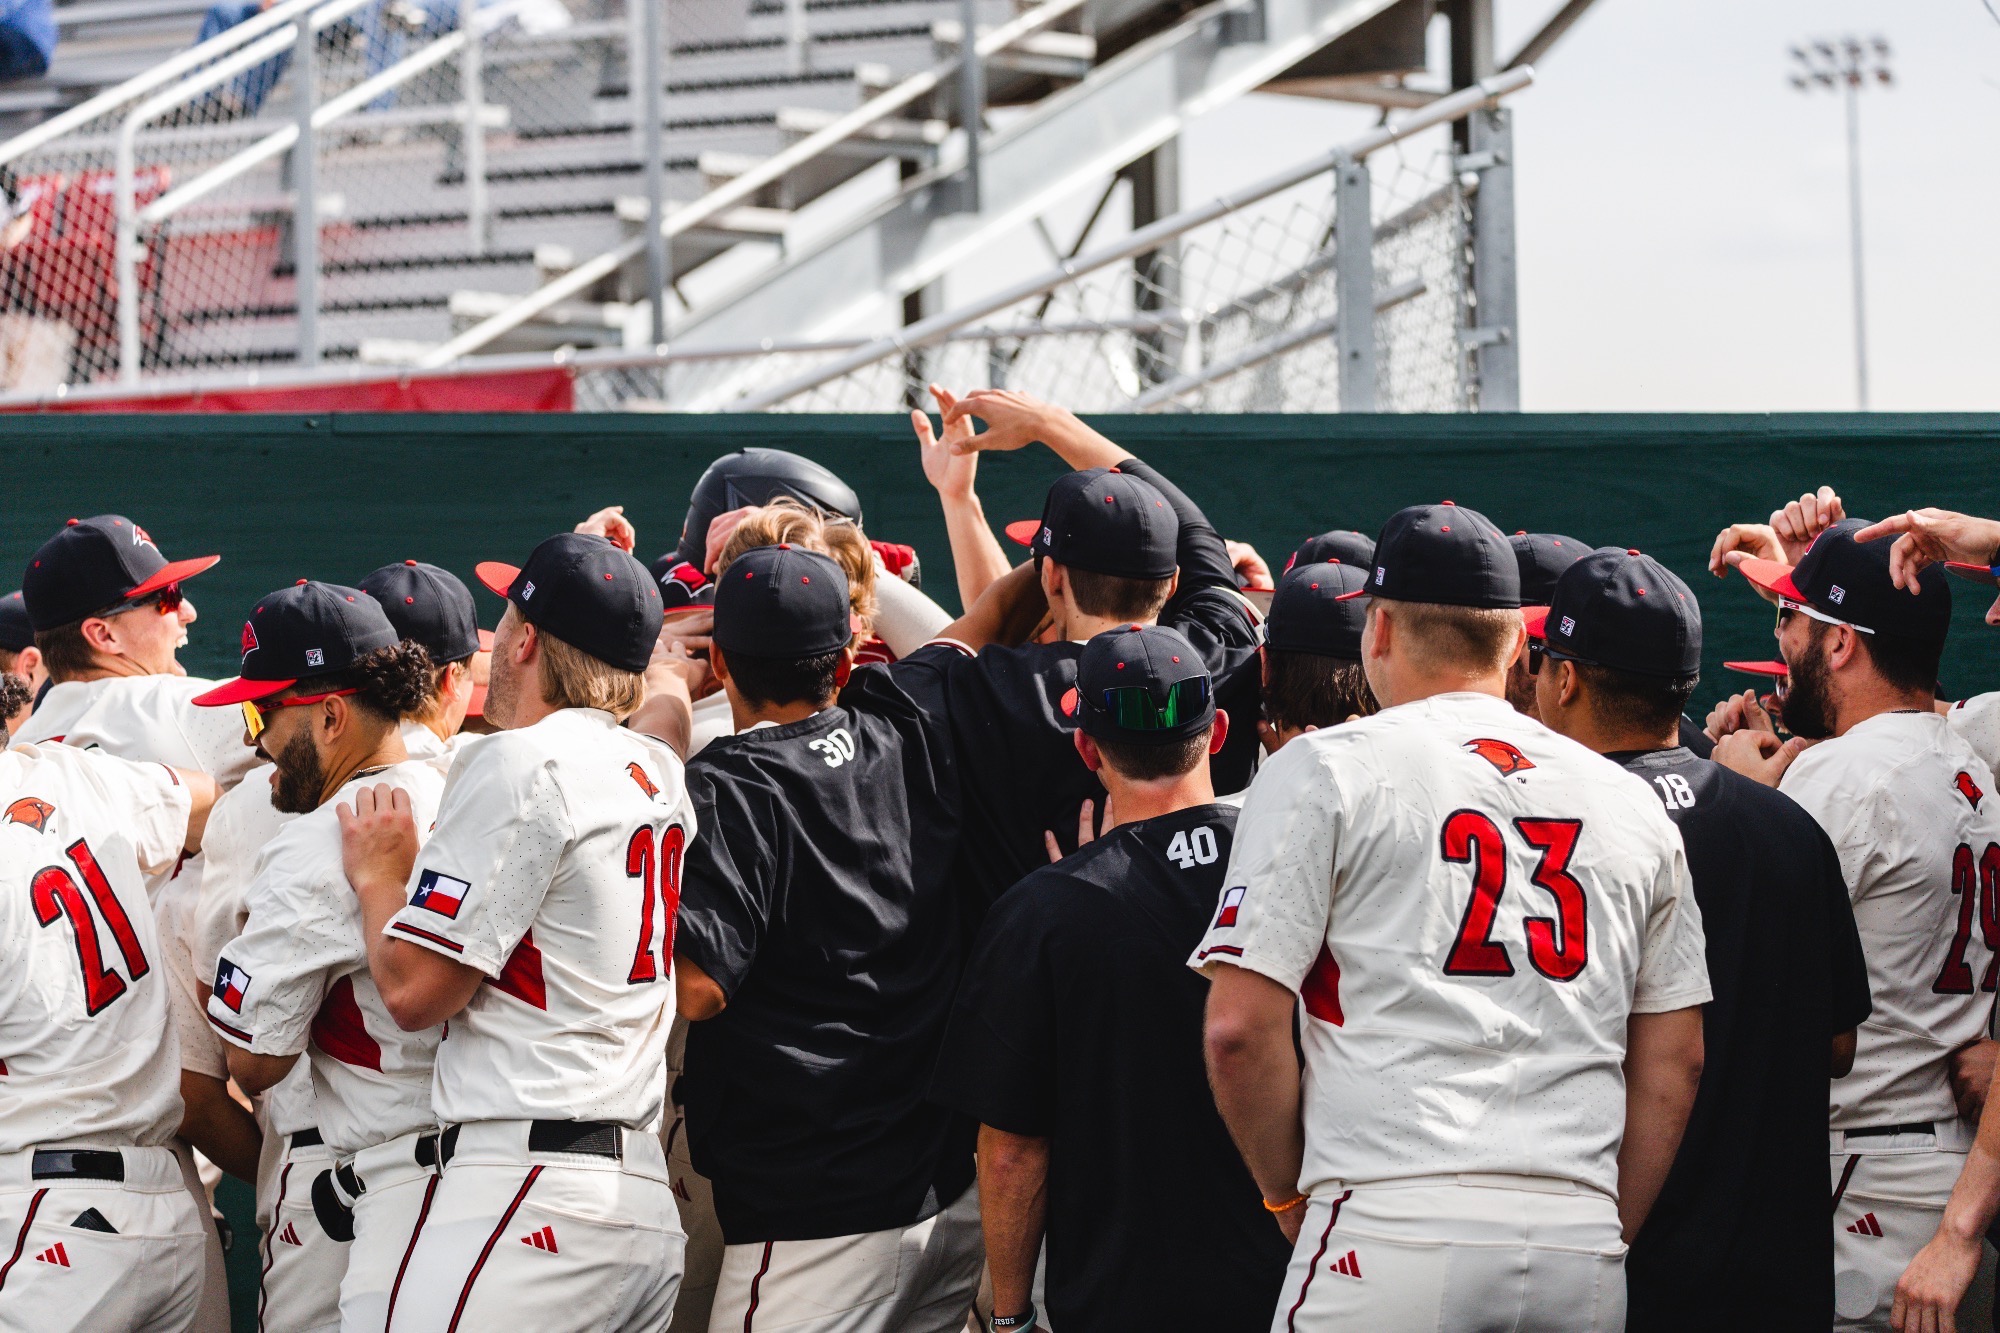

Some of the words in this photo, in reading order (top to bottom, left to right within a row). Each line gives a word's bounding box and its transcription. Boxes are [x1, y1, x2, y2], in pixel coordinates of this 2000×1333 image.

[809, 728, 855, 768] 30
[1653, 773, 1696, 810] 18
[1166, 825, 1219, 869] 40
[1440, 808, 1588, 982] 23
[30, 837, 150, 1017] 21
[626, 823, 686, 985] 28
[1932, 842, 2000, 994] 29
[994, 1317, 1015, 1326] JESUS
